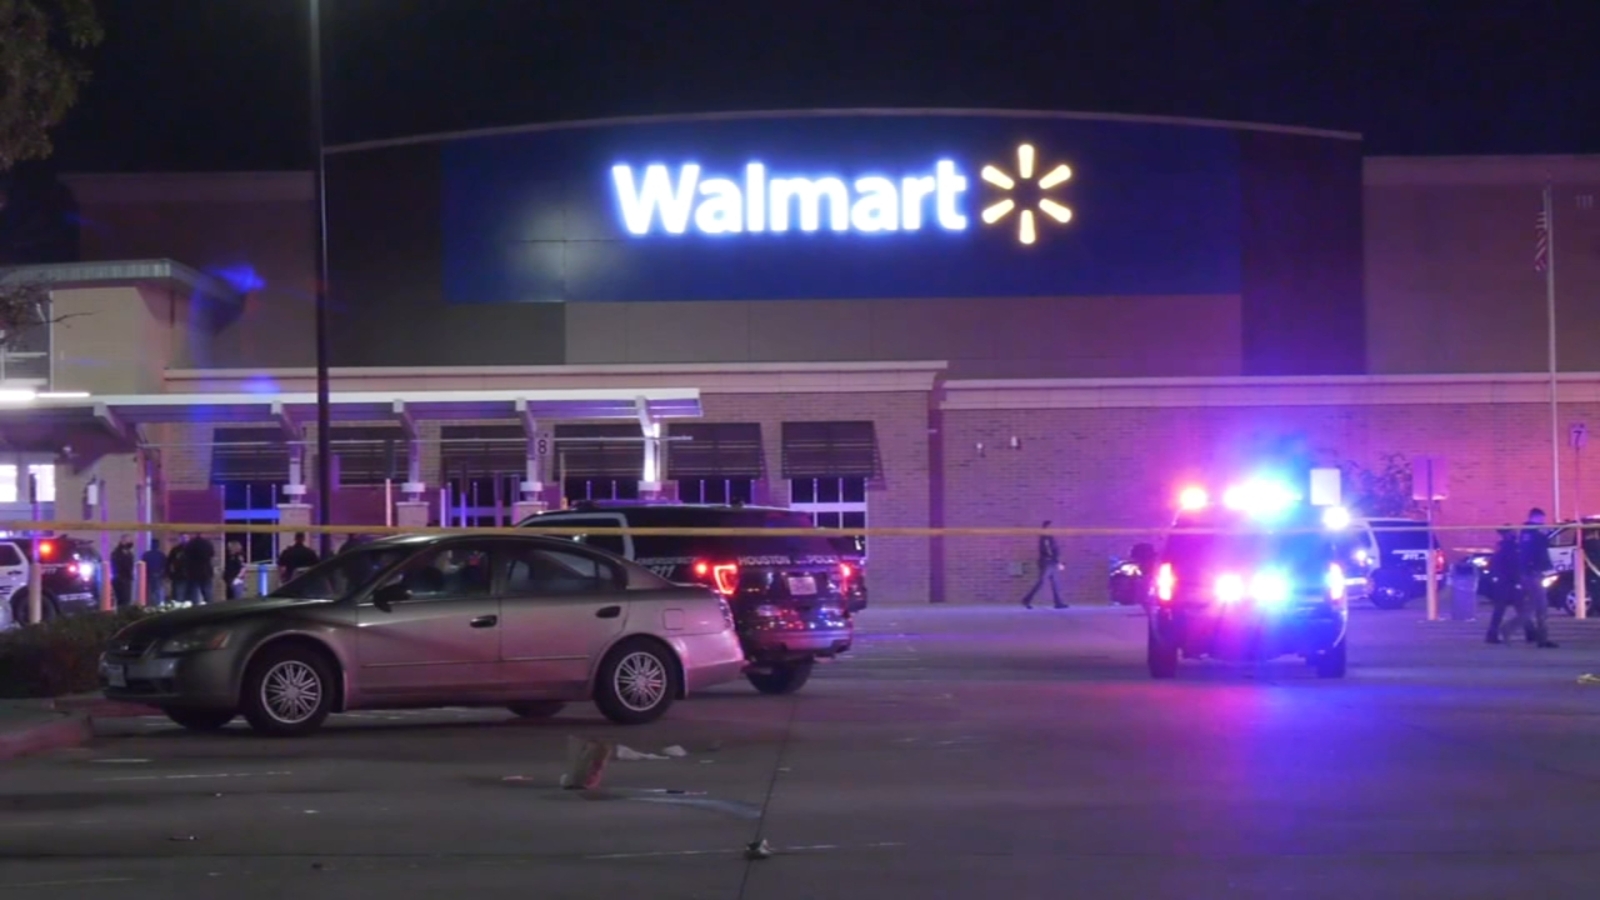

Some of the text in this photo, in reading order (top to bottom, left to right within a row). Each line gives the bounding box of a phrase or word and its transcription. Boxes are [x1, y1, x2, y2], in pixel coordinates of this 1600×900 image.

[612, 160, 967, 234] Walmart
[537, 438, 547, 455] 8
[738, 555, 791, 566] HOUSTON
